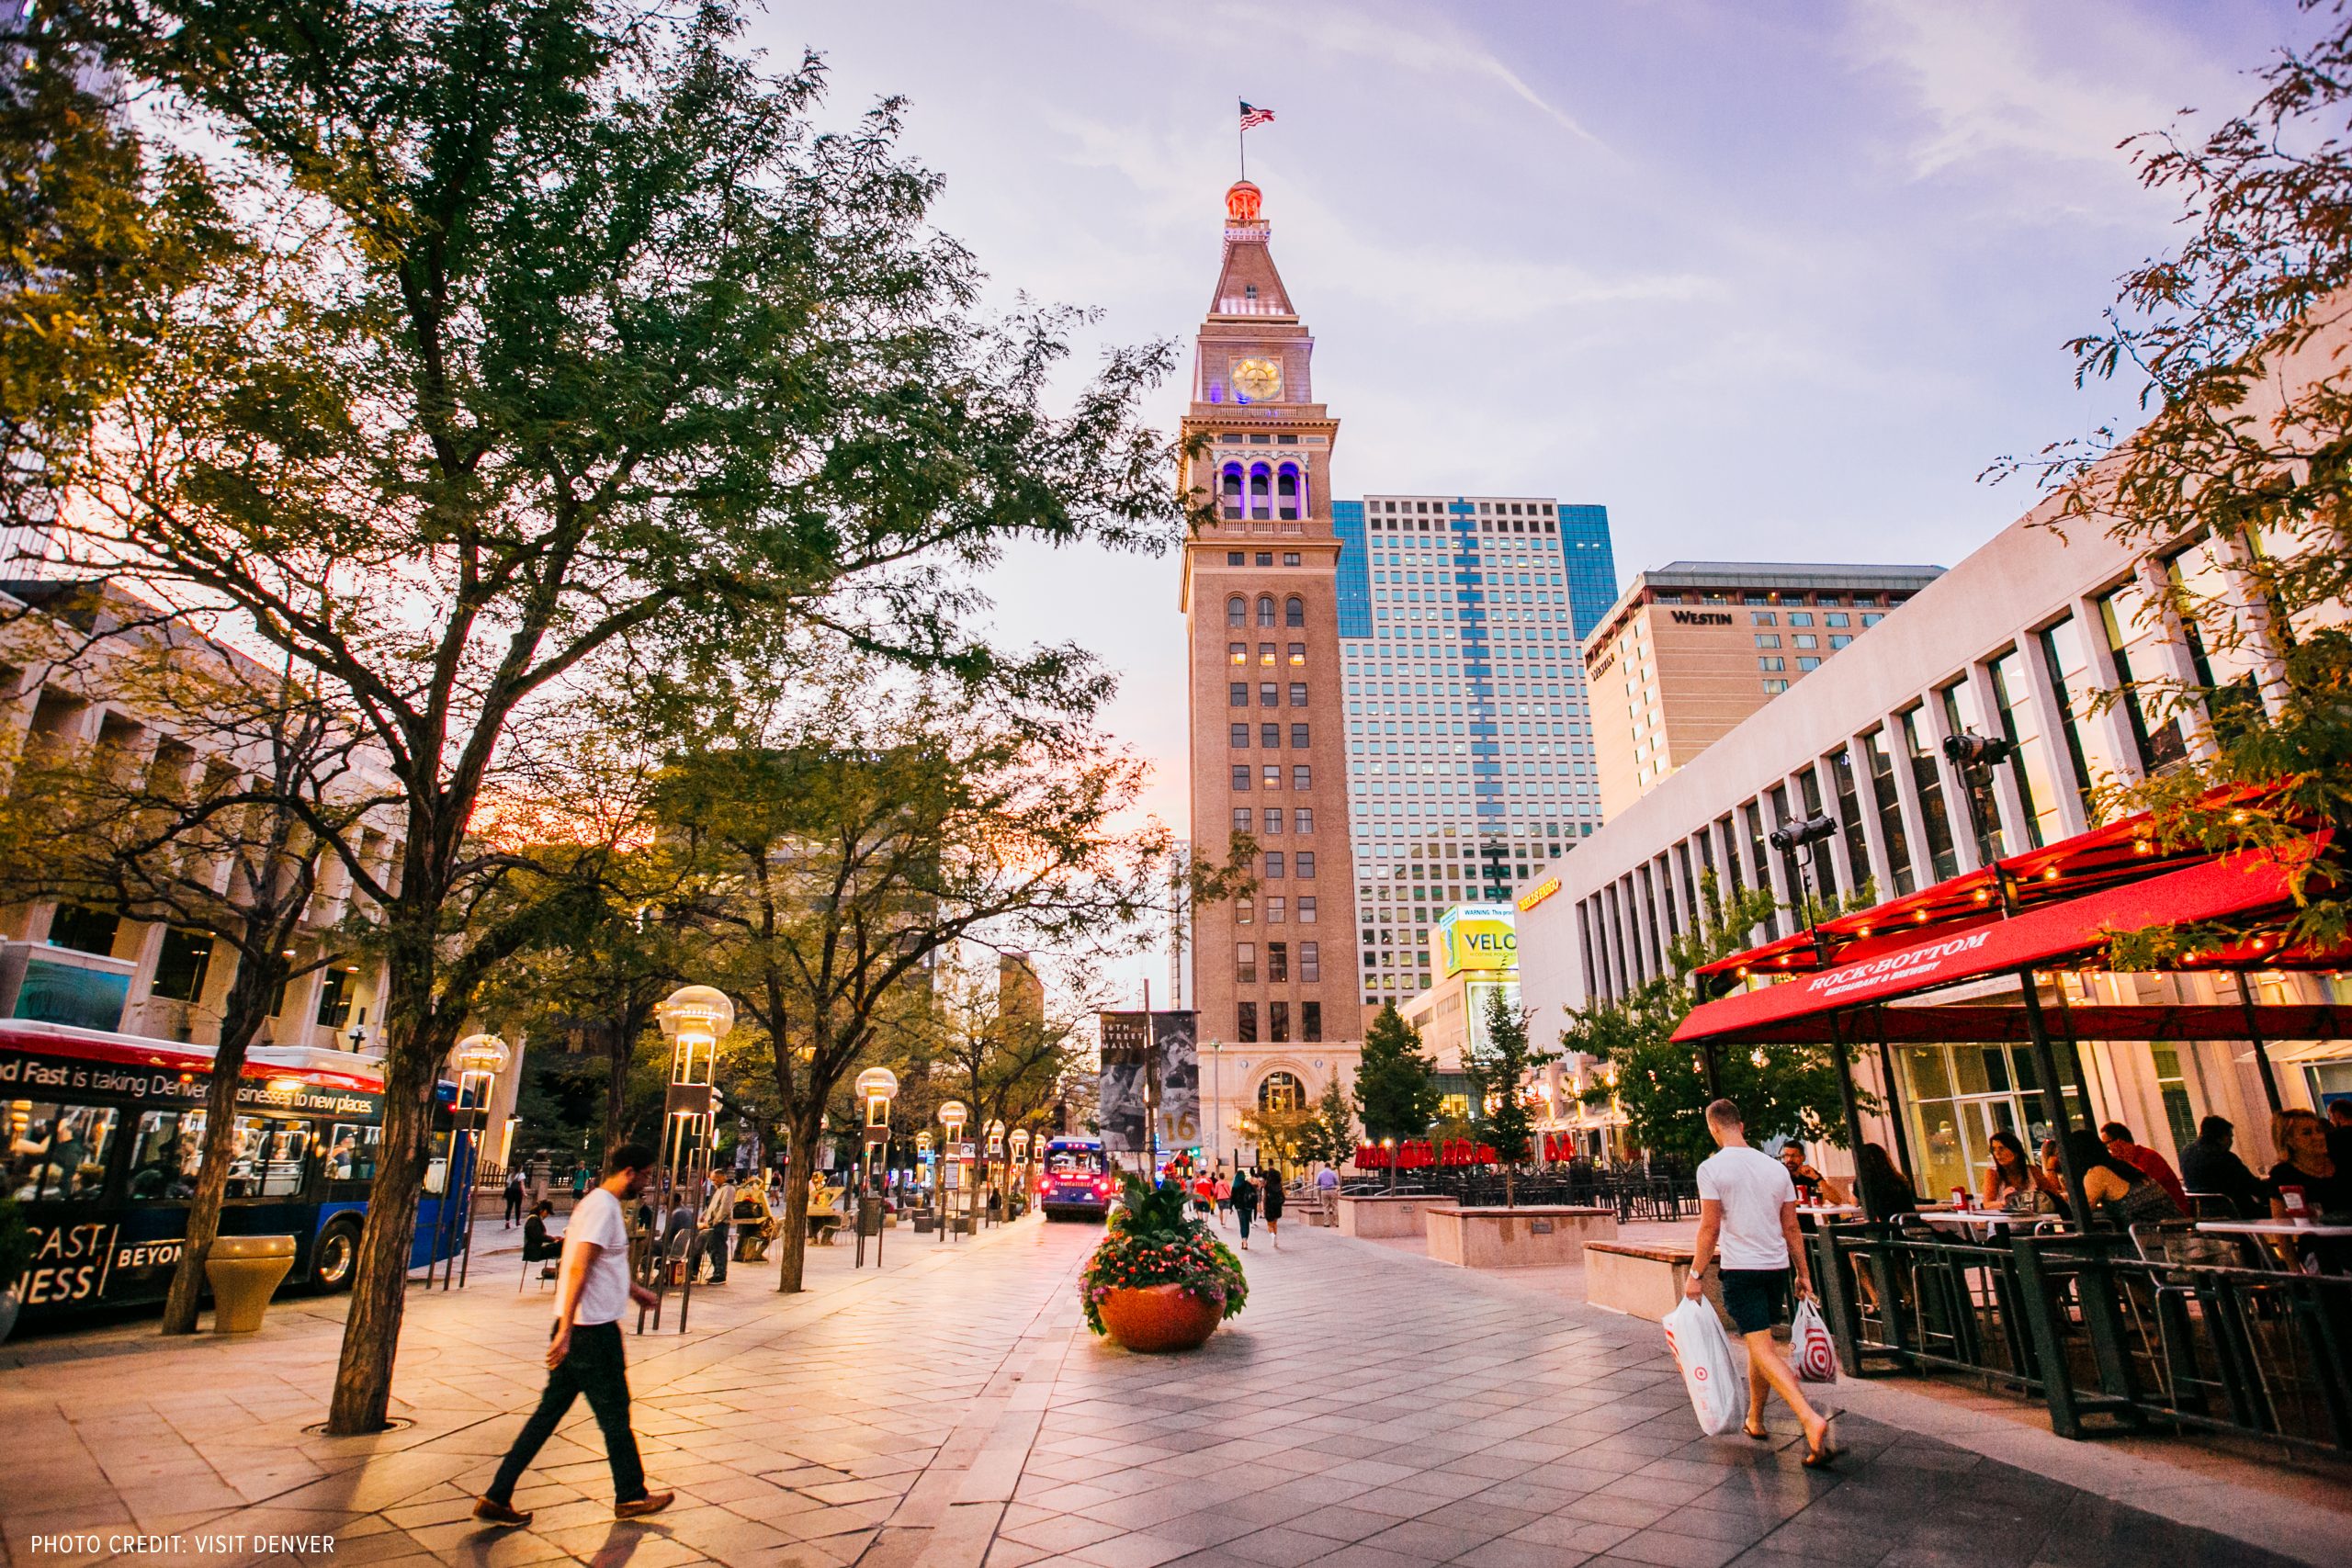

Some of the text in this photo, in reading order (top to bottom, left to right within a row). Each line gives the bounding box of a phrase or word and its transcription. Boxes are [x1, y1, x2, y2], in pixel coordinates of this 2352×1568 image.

[1871, 931, 1991, 973] BOTTOM
[1824, 976, 1883, 997] RESTAURANT
[1889, 961, 1941, 981] BREWERY
[22, 1061, 70, 1087] Fast
[72, 1066, 87, 1088] is
[92, 1069, 148, 1097] taking
[293, 1091, 307, 1107] to
[309, 1095, 336, 1110] new
[335, 1094, 373, 1114] places.
[1162, 1111, 1195, 1142] 16
